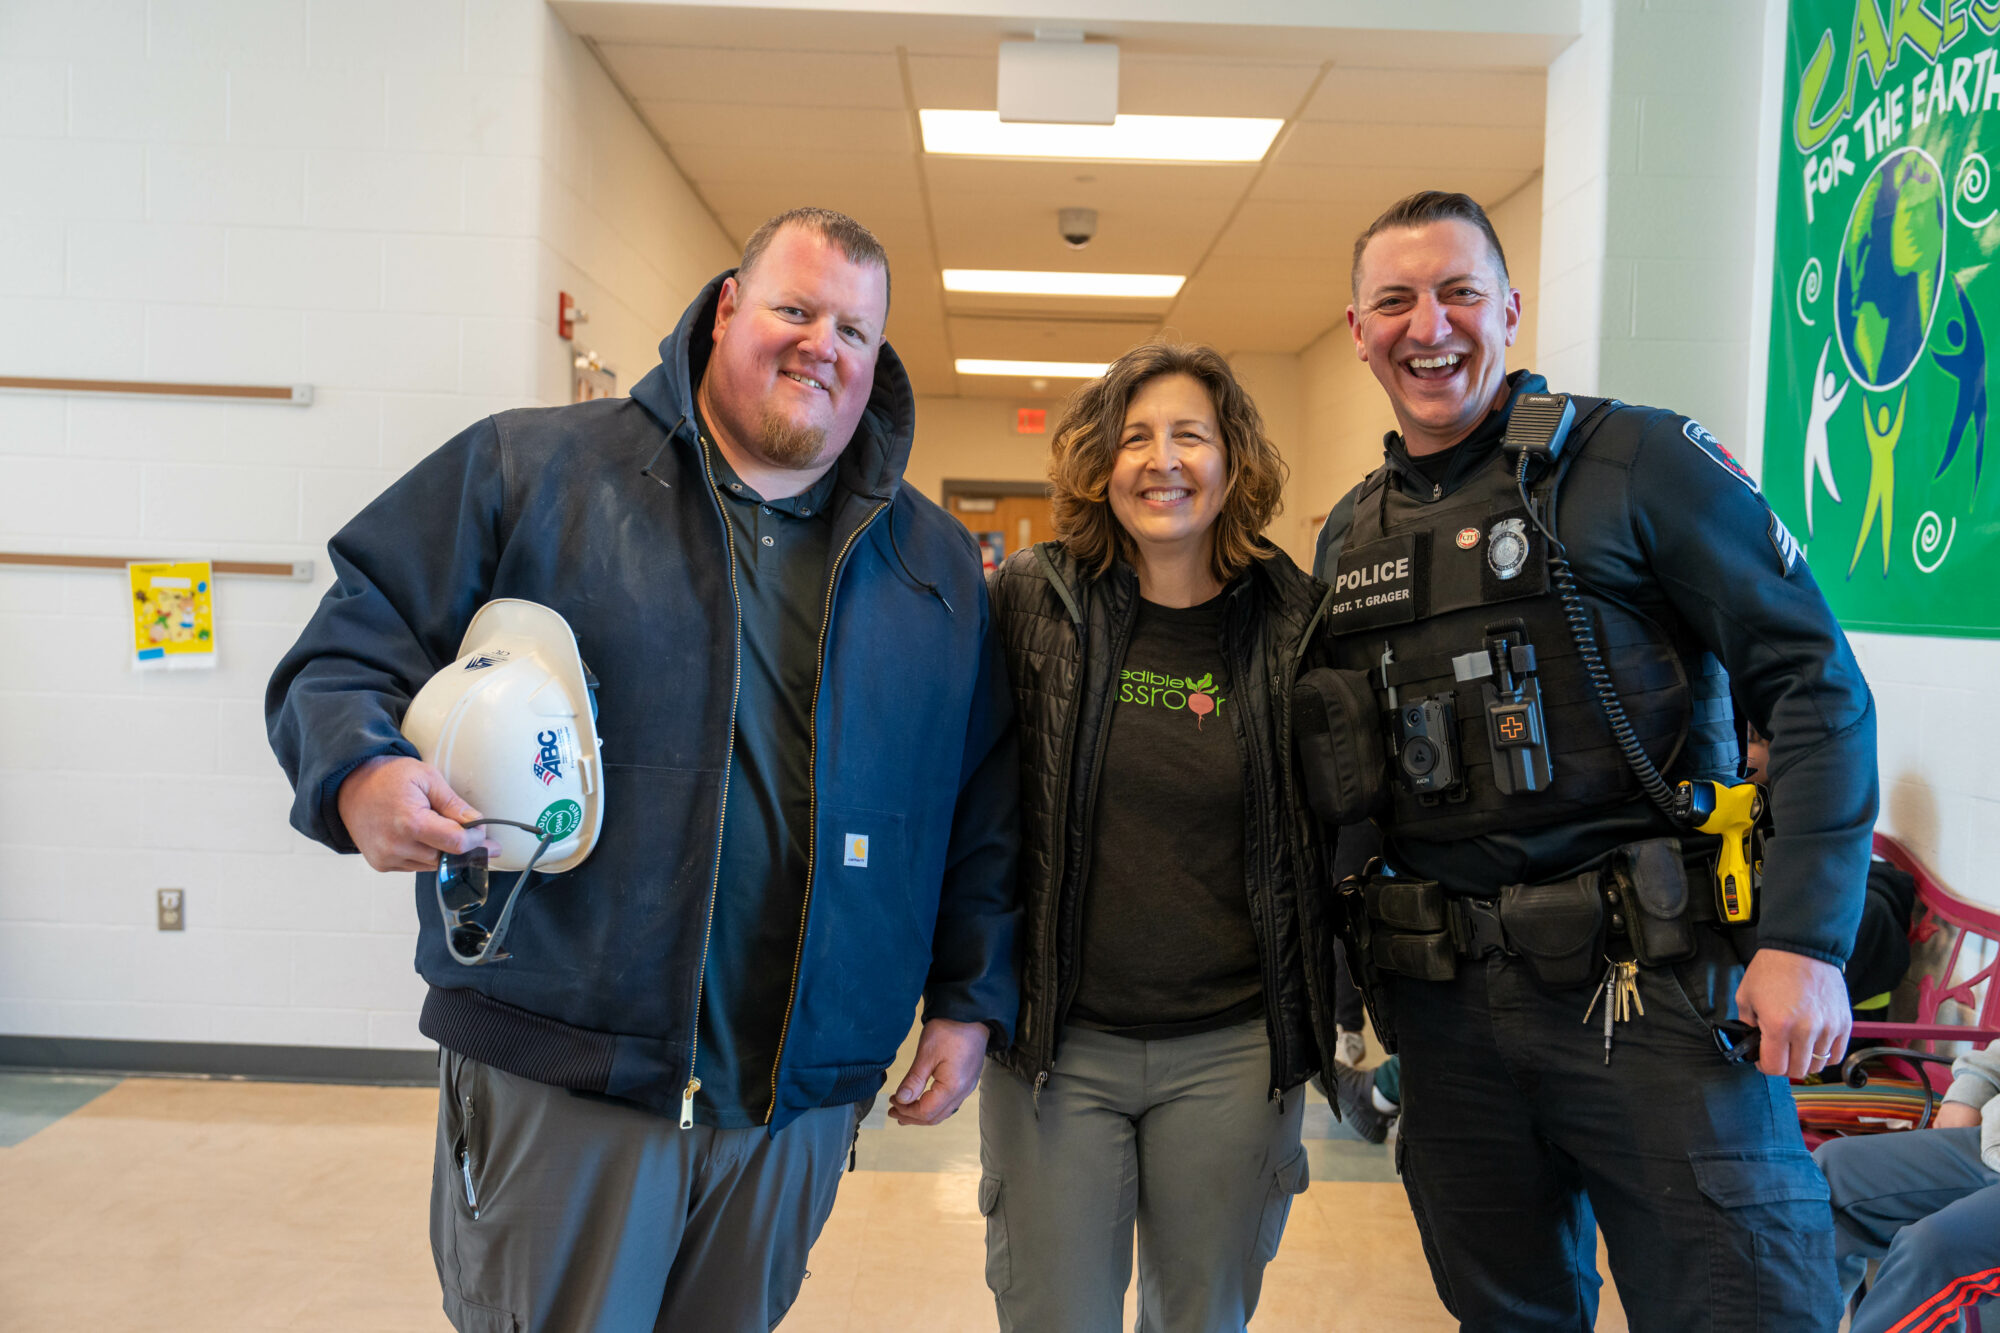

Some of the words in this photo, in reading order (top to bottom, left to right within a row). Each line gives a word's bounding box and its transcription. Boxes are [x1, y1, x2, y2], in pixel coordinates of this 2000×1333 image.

[1803, 134, 1855, 225] FOR
[1853, 83, 1904, 161] THE
[1911, 47, 2000, 130] EARTH
[1335, 557, 1409, 594] POLICE
[1332, 601, 1352, 615] SGT.
[1355, 598, 1363, 609] T.
[1365, 588, 1410, 607] GRAGER
[1120, 670, 1185, 689] edible
[538, 730, 562, 779] ABC
[555, 812, 563, 832] OSHA
[567, 803, 580, 832] TRAINED
